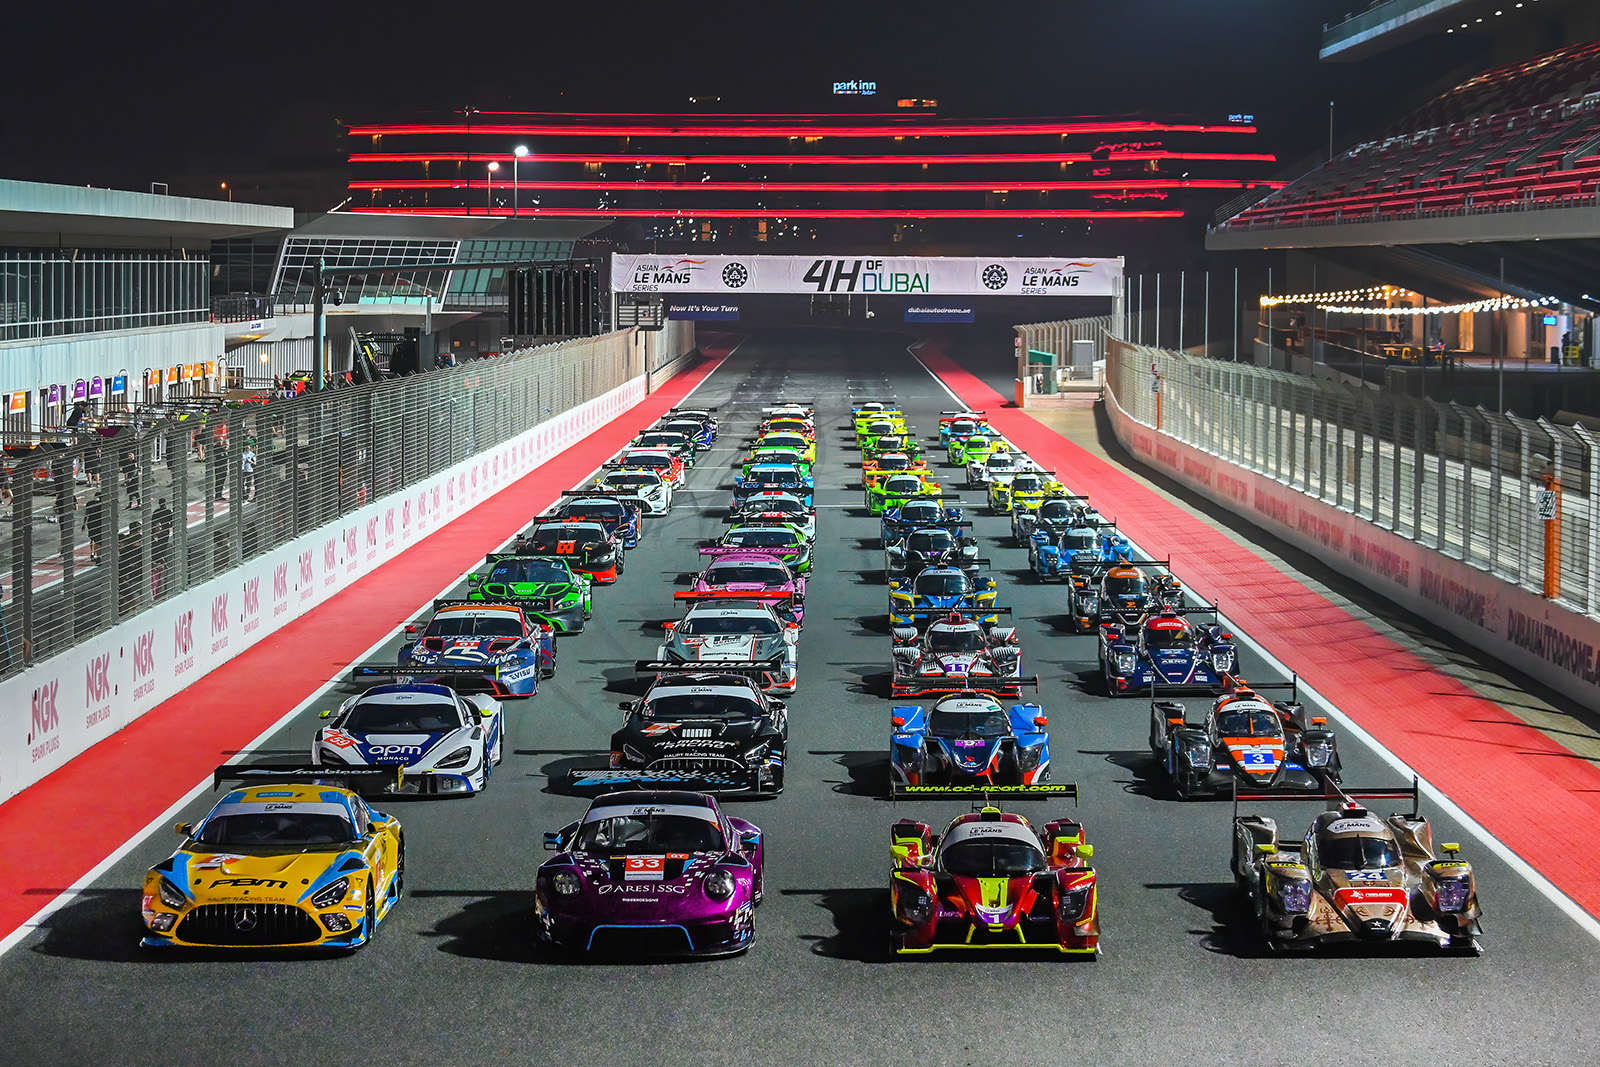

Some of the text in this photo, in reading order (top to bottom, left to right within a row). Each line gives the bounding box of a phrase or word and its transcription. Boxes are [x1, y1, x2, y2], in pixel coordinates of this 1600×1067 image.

[833, 80, 858, 94] park
[859, 80, 876, 90] inn
[636, 264, 659, 272] ASIAN
[866, 260, 883, 270] OF
[803, 260, 863, 292] 4H
[1024, 267, 1048, 275] ASIAN
[634, 272, 691, 284] LE MANS
[862, 273, 929, 293] DUBAI
[1022, 276, 1080, 287] LE MANS
[632, 284, 659, 292] SERIES
[1020, 287, 1047, 295] SERIES
[243, 576, 260, 619] NGK
[211, 592, 229, 637] NGK
[174, 608, 193, 659] NGK
[133, 628, 155, 682] NGK
[948, 664, 967, 672] 11
[86, 651, 110, 708] NGK
[133, 678, 155, 702] SPARK PLUGS
[31, 677, 59, 741] NGK
[86, 704, 110, 729] SPARK PLUGS
[329, 737, 351, 746] 59
[32, 735, 60, 763] SPARK PLUGS
[368, 745, 422, 757] apm
[1251, 753, 1265, 764] 3
[905, 784, 1067, 792] www.cd-sport.com
[630, 859, 660, 869] 33
[1350, 871, 1384, 881] 24
[614, 884, 686, 894] ARES SSG
[988, 914, 1000, 923] 1
